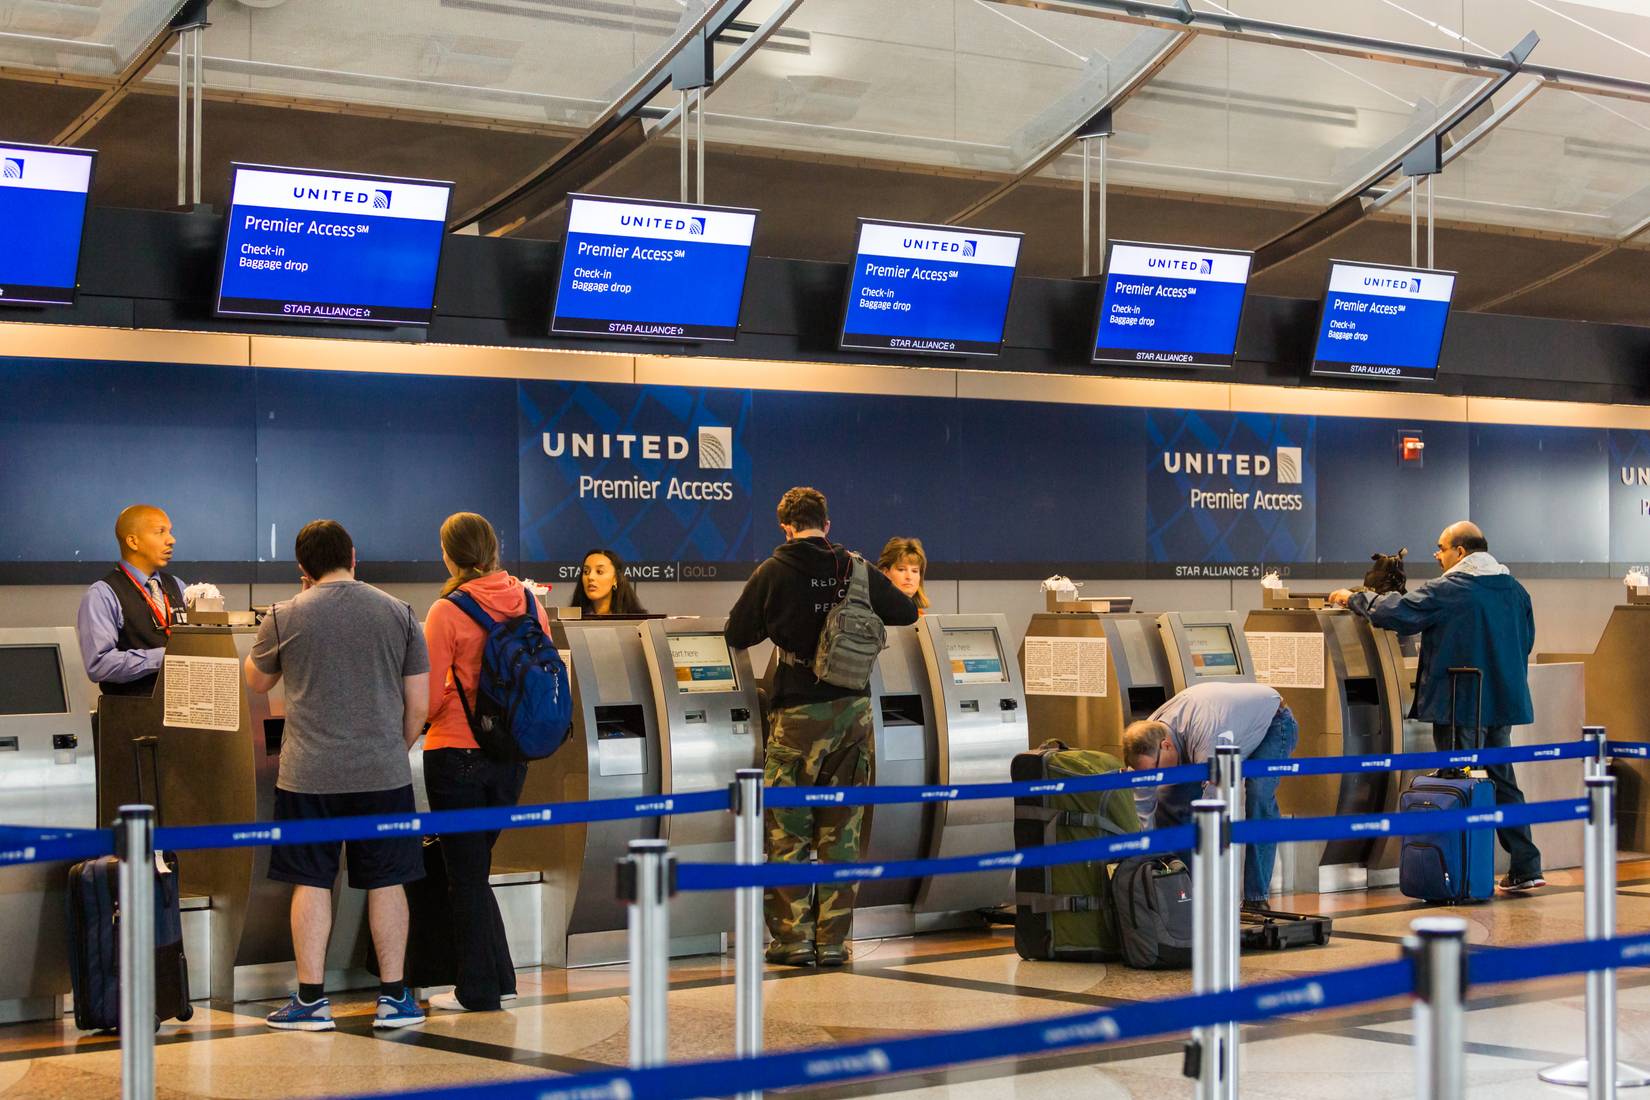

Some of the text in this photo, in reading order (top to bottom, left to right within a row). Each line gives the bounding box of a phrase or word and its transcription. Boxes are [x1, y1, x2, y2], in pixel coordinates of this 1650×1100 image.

[293, 187, 369, 204] UNITED
[245, 215, 304, 233] Premier
[620, 215, 685, 230] UNITED
[241, 243, 285, 256] Check-in
[578, 241, 629, 258] Premier
[903, 239, 960, 252] UNITED
[239, 257, 309, 273] Baggage drop
[1148, 258, 1197, 270] UNITED
[574, 267, 612, 279] Check-in
[865, 263, 910, 279] Premier
[572, 280, 632, 295] Baggage drop
[1115, 281, 1154, 296] Premier
[1364, 277, 1407, 289] UNITED
[861, 287, 895, 298] Check-in
[283, 304, 363, 317] STAR ALLIANCE
[859, 299, 911, 312] Baggage drop
[1111, 304, 1140, 314] Check-in
[1334, 299, 1368, 312] Premier
[1110, 315, 1155, 327] Baggage drop
[609, 323, 677, 335] STAR ALLIANCE
[890, 339, 911, 348] STAR
[1136, 352, 1154, 360] STAR
[542, 432, 690, 460] UNITED
[1164, 452, 1271, 476] UNITED
[579, 475, 733, 501] Premier Access
[1190, 488, 1302, 511] Premier Access
[683, 566, 717, 577] GOLD
[1175, 566, 1200, 576] STAR
[1202, 566, 1249, 577] ALLIANCE
[811, 577, 837, 587] RED
